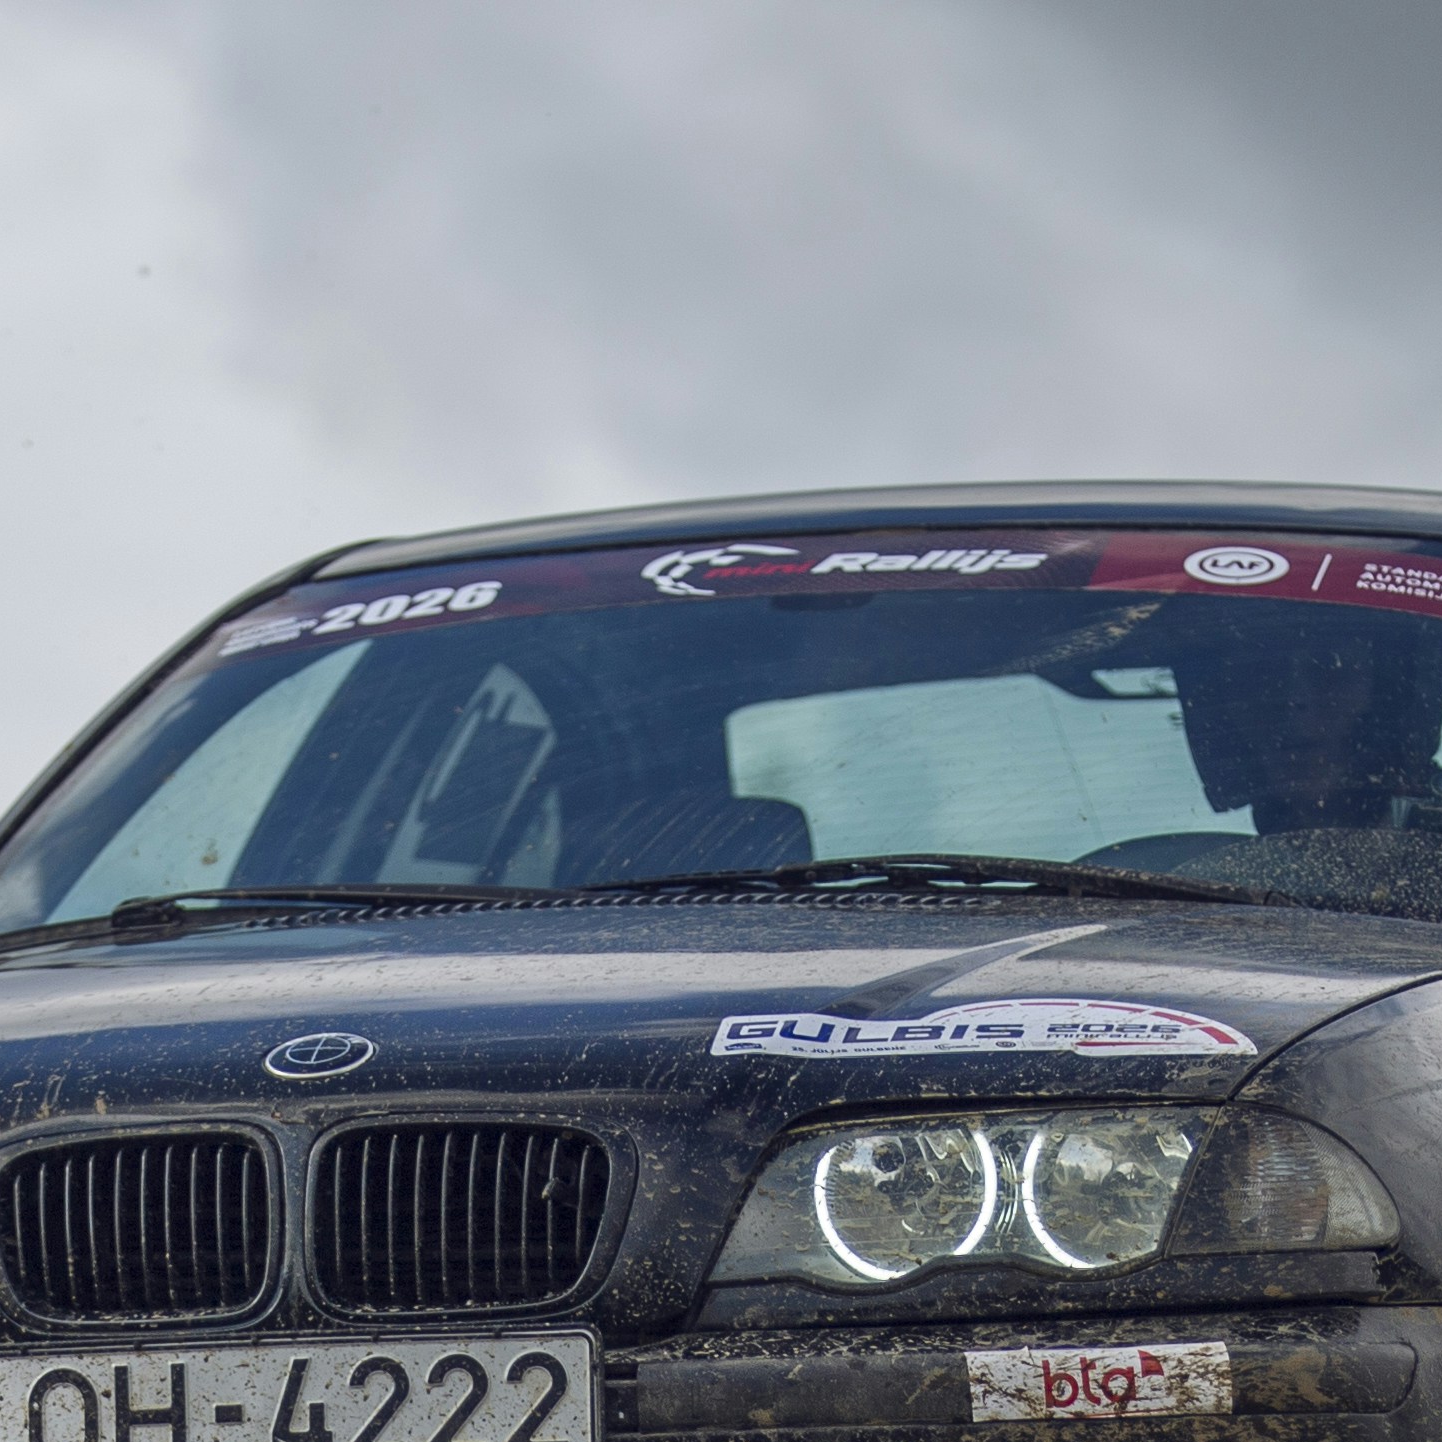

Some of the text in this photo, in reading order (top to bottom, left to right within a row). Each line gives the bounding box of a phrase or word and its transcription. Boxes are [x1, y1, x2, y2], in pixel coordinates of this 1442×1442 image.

[311, 580, 503, 636] 2026
[726, 1020, 1025, 1043] GULBIS
[1042, 1356, 1137, 1408] bta
